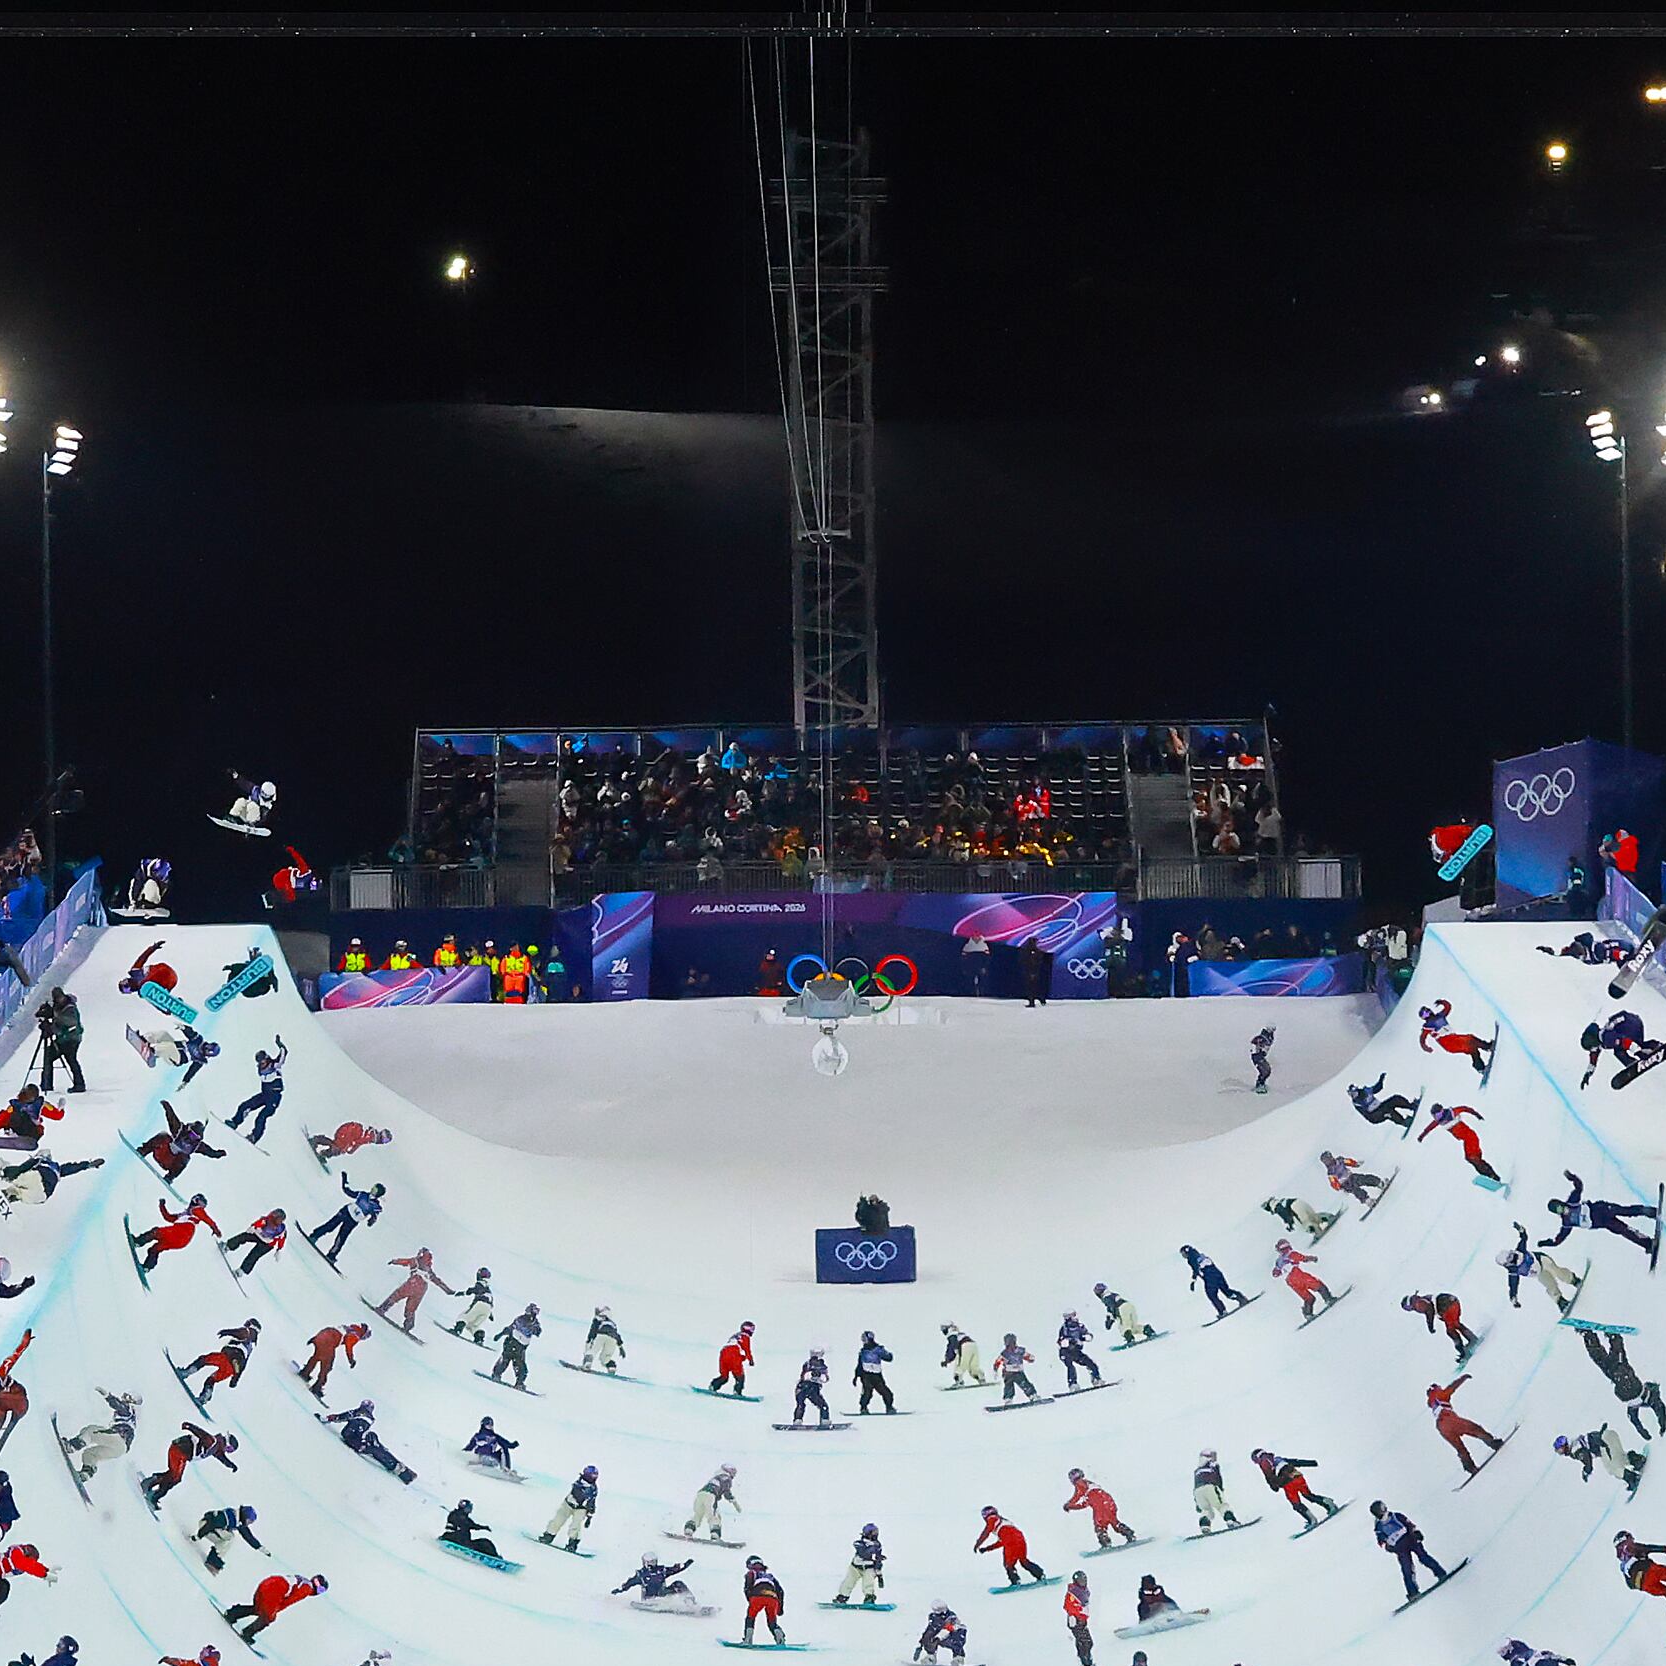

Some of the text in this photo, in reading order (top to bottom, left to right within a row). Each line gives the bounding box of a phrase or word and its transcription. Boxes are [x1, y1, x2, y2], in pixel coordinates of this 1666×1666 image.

[1443, 828, 1491, 876] BURTON
[691, 903, 806, 913] MILANO CORTINA 2026
[138, 987, 195, 1022] BURTON
[213, 961, 269, 1008] BURTON
